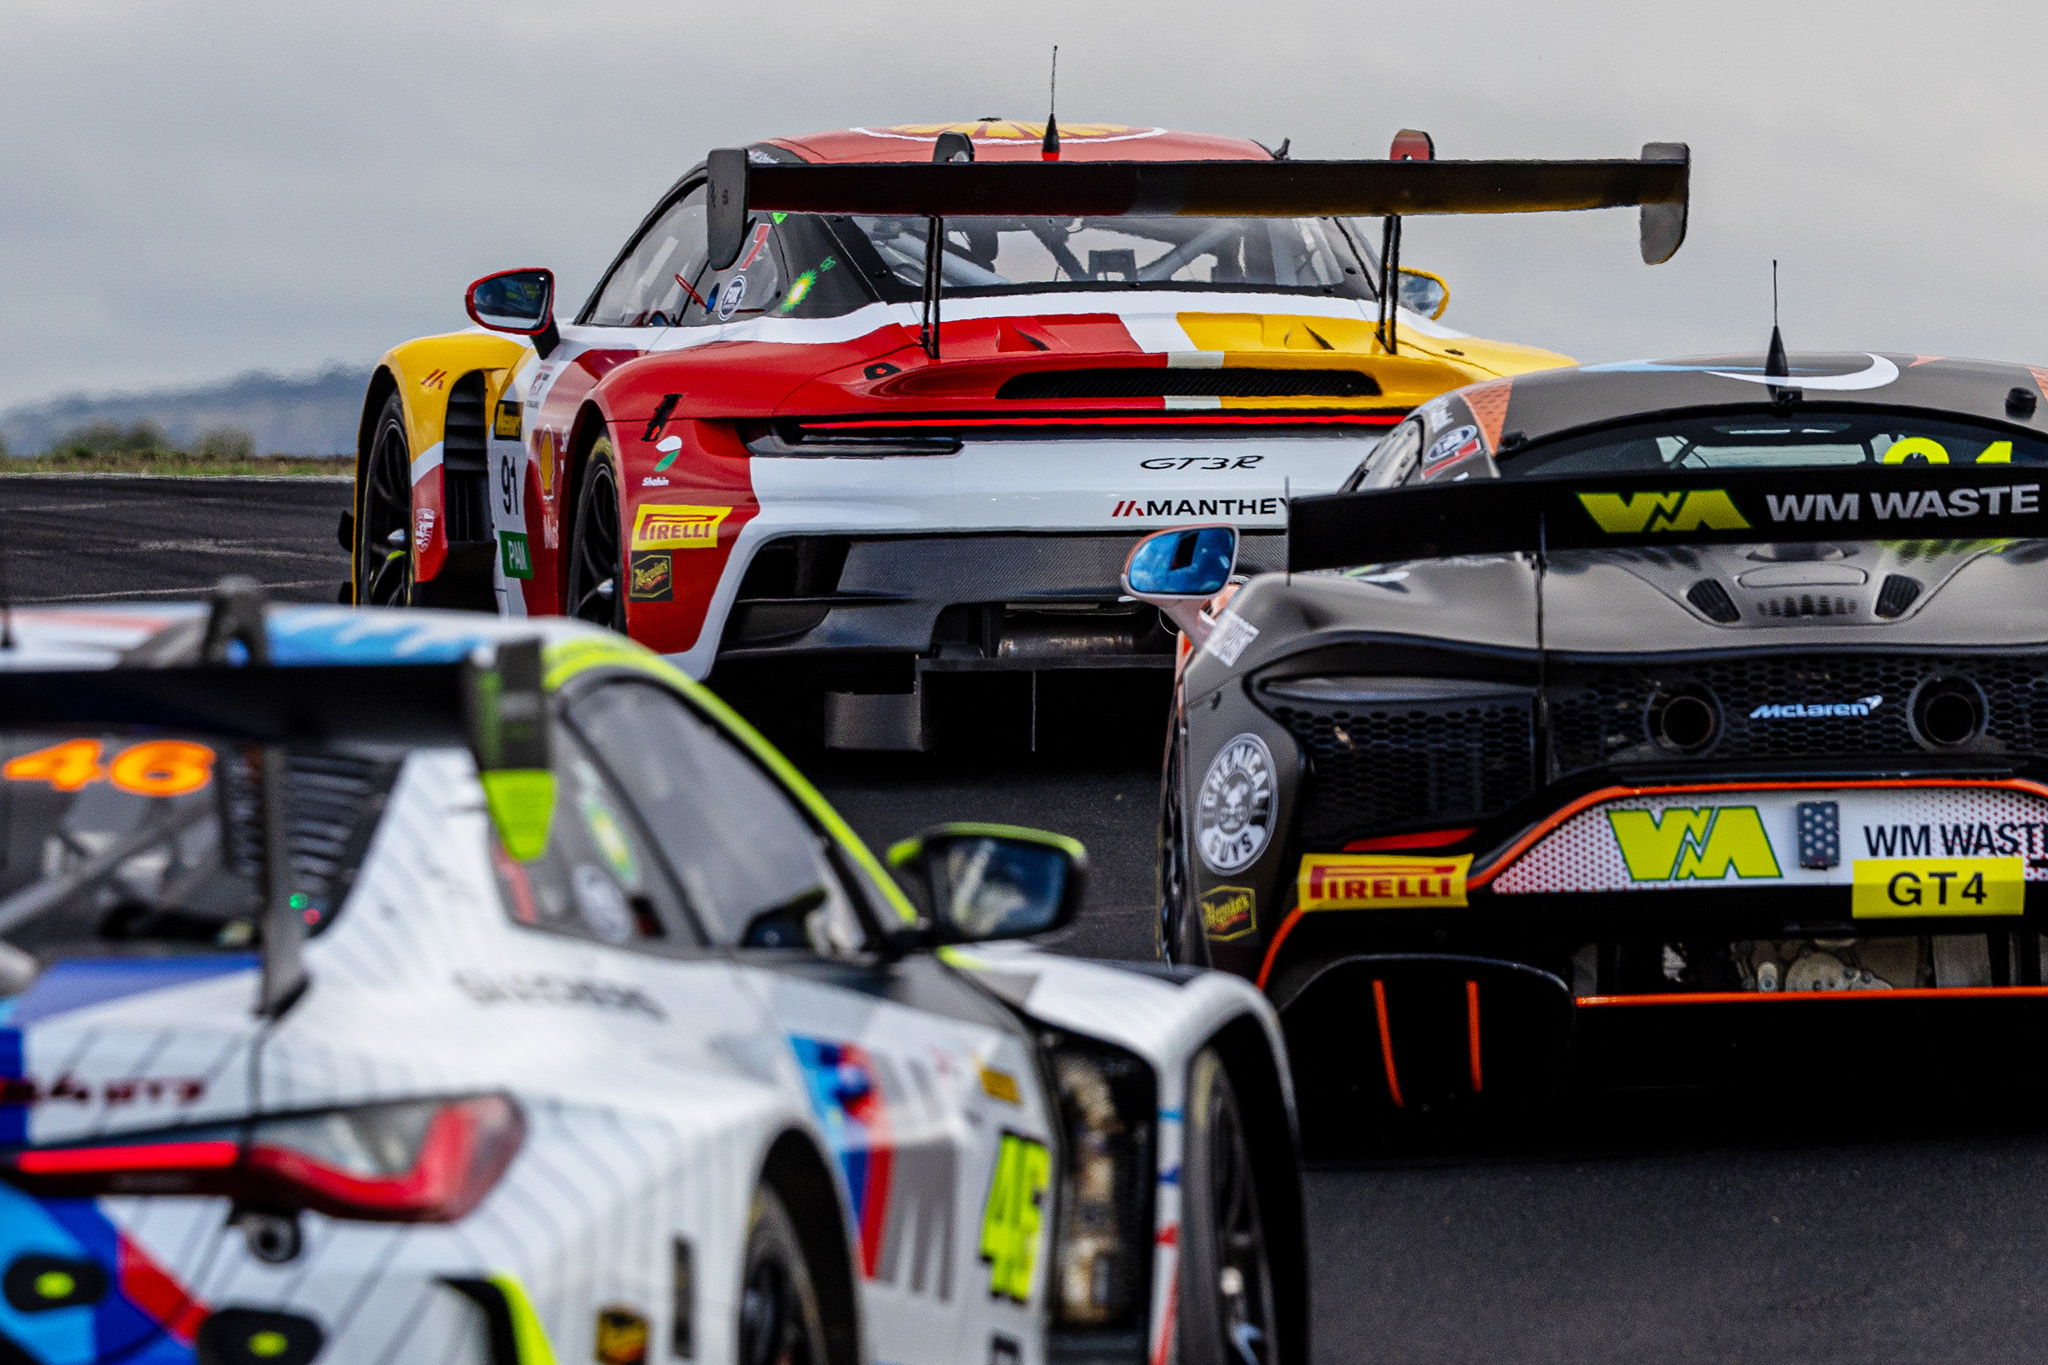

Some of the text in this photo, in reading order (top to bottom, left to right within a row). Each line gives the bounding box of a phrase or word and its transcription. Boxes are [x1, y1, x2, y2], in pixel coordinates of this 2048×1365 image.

[501, 455, 519, 515] 91
[1766, 493, 1860, 522] WM
[1870, 484, 2041, 519] WASTE
[638, 513, 719, 541] PIRELLI
[1749, 702, 1870, 719] McLaren
[2, 737, 217, 797] 46
[1210, 832, 1254, 862] GUYS
[1863, 825, 1932, 857] WM
[1940, 823, 2048, 857] WAST
[1310, 864, 1458, 900] PIRELLI
[1887, 871, 1988, 907] GT4
